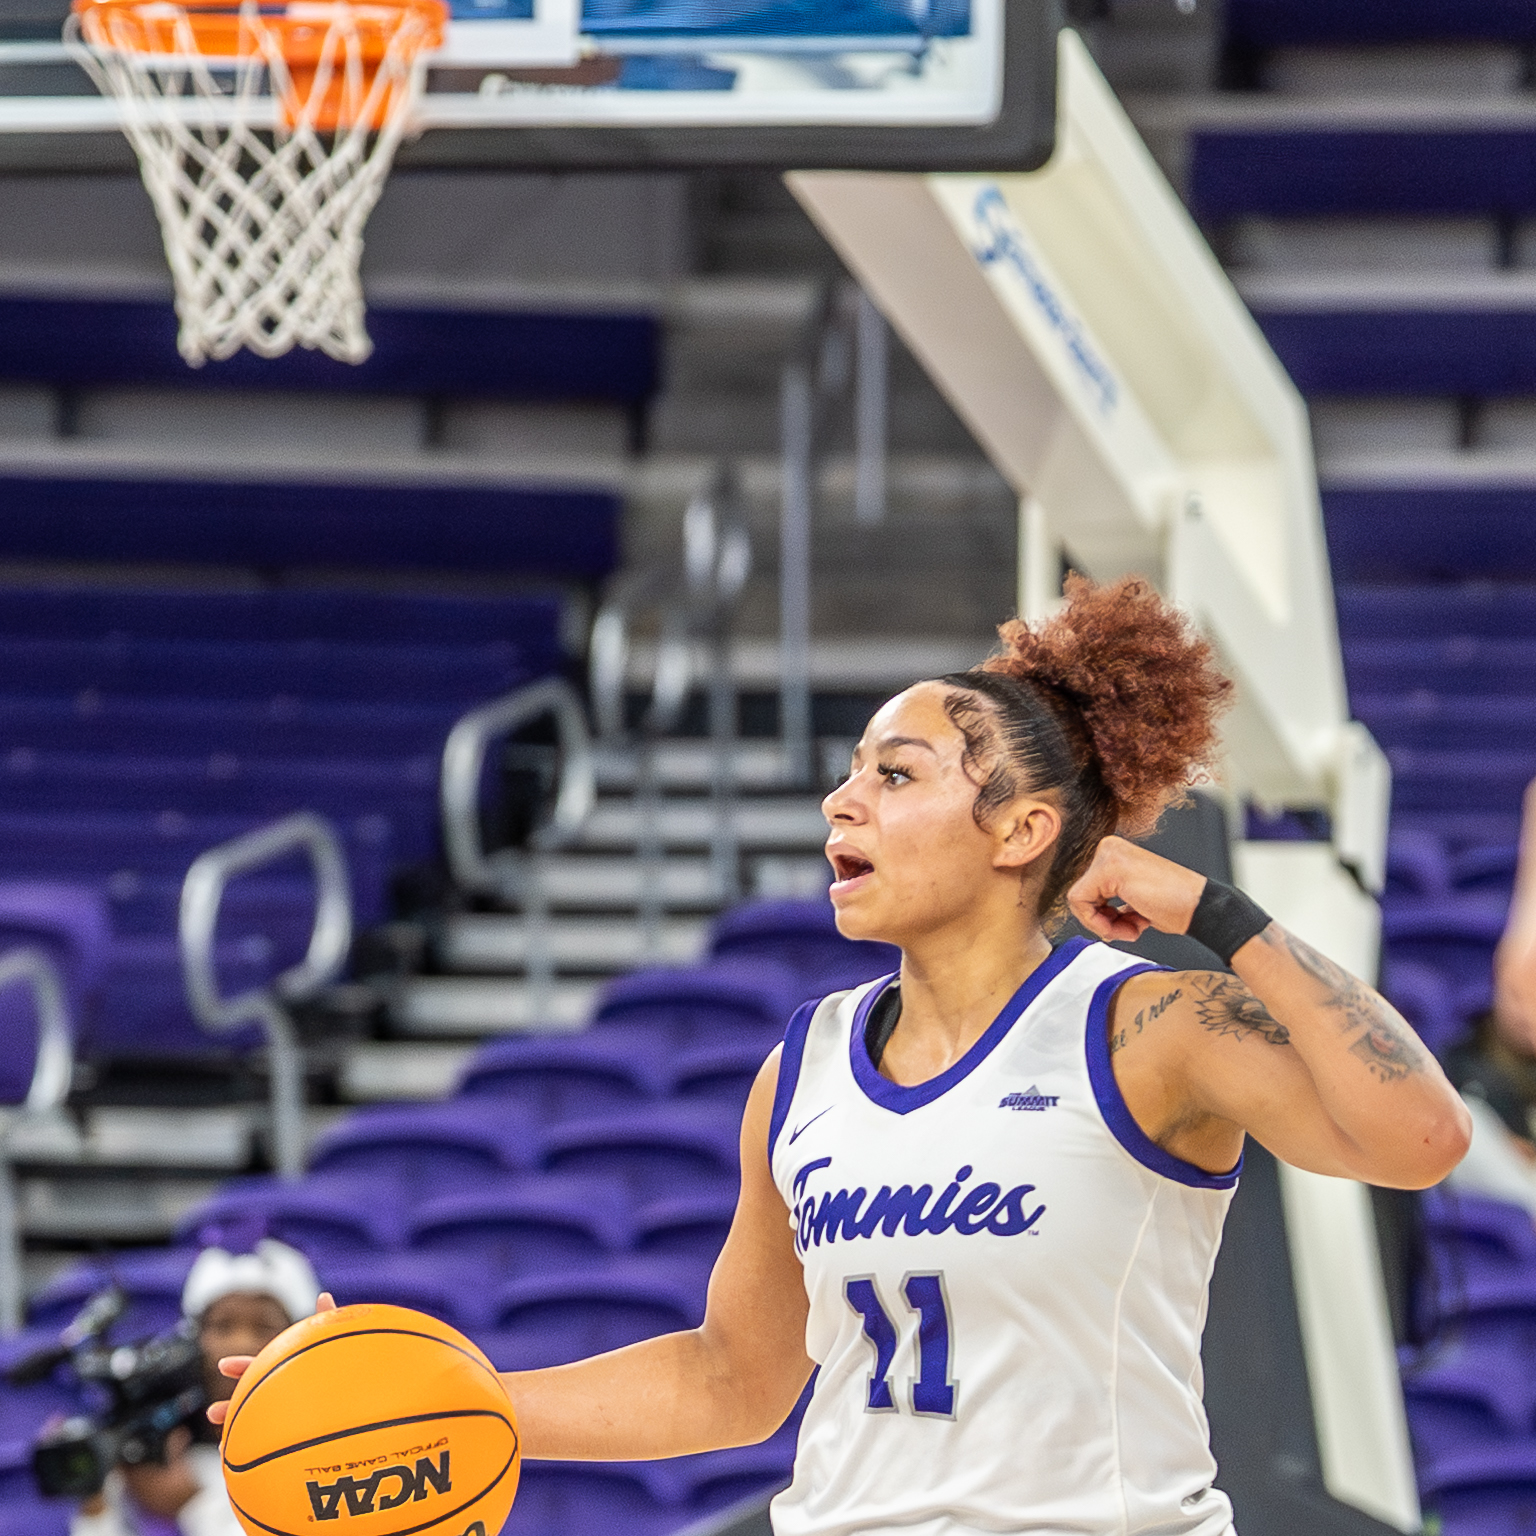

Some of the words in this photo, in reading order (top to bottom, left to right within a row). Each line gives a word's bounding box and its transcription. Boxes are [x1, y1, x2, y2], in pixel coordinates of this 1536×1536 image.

[998, 1096, 1060, 1108] SUMMIT
[793, 1156, 1046, 1257] Tommies
[842, 1270, 960, 1421] 11
[304, 1461, 344, 1476] BALL
[306, 1450, 452, 1522] NCAA
